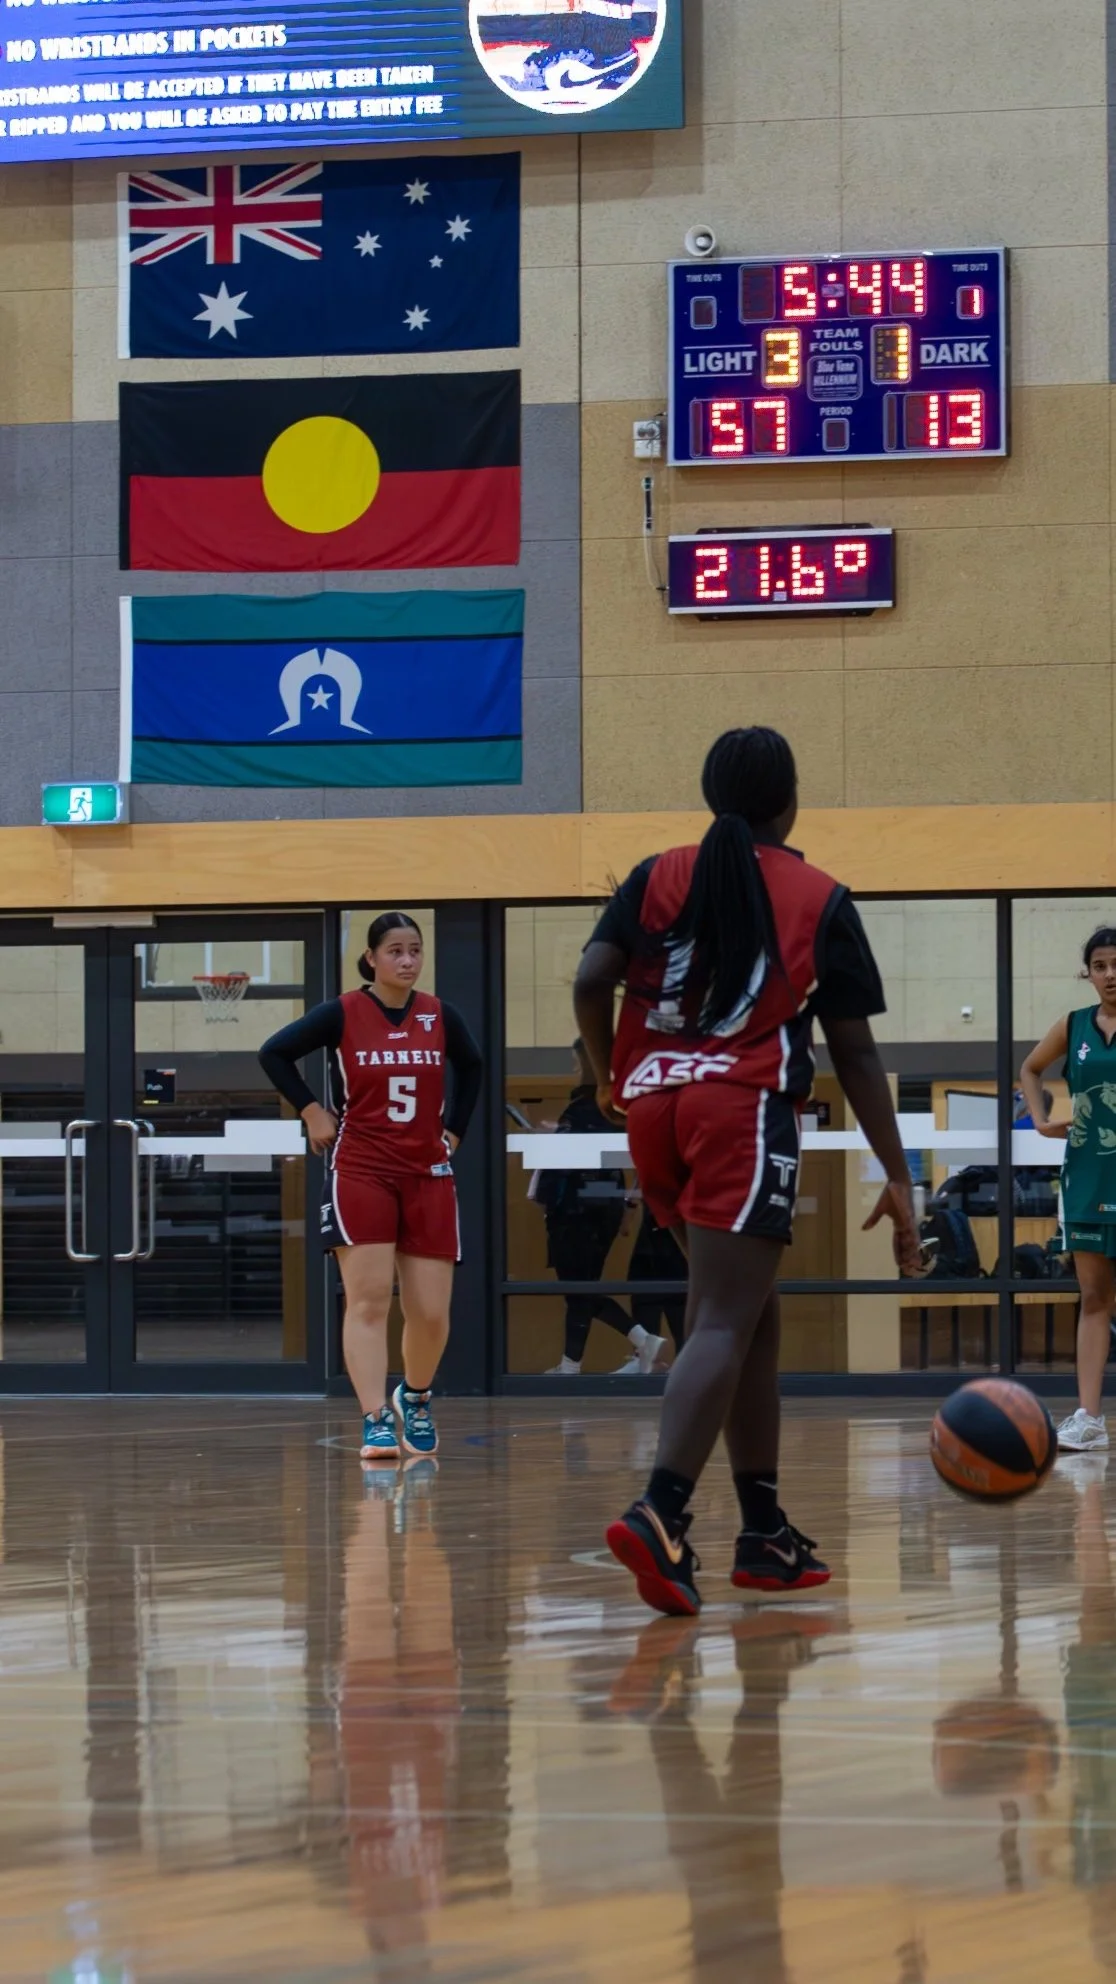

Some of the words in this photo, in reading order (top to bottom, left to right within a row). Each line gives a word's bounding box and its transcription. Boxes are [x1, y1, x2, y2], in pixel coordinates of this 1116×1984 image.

[7, 40, 36, 62] NO
[40, 31, 169, 60] WRISTBANDS
[173, 29, 196, 53] IN
[200, 25, 287, 51] POCKETS
[83, 82, 121, 102] WILL
[123, 81, 145, 100] BE
[146, 76, 225, 99] ACCEPTED
[228, 75, 243, 94] IF
[246, 73, 287, 93] THEY
[289, 70, 333, 90] HAVE
[336, 67, 377, 88] BEEN
[380, 65, 434, 85] TAKEN
[10, 116, 68, 137] RIPPED
[70, 114, 105, 133] AND
[108, 111, 142, 131] YOU
[145, 109, 184, 129] WILL
[186, 108, 208, 127] BE
[210, 105, 262, 125] ASKED
[265, 103, 288, 122] TO
[290, 101, 325, 121] PAY
[327, 100, 358, 119] THE
[360, 97, 414, 117] ENTRY
[416, 95, 444, 115] FEE
[686, 274, 702, 283] TIME
[703, 273, 722, 282] OUTS
[952, 264, 969, 273] TIME
[969, 263, 988, 272] OUTS
[783, 260, 924, 317] 5:44
[972, 288, 980, 315] 1
[809, 341, 864, 352] FOULS
[813, 328, 860, 339] TEAM
[684, 351, 757, 374] LIGHT
[764, 331, 799, 384] 3
[896, 327, 908, 380] 1
[921, 343, 989, 364] DARK
[711, 402, 786, 452] 57
[820, 406, 853, 416] PERIOD
[929, 394, 981, 446] 13
[356, 1051, 441, 1066] TARNEIT
[388, 1076, 416, 1123] 5
